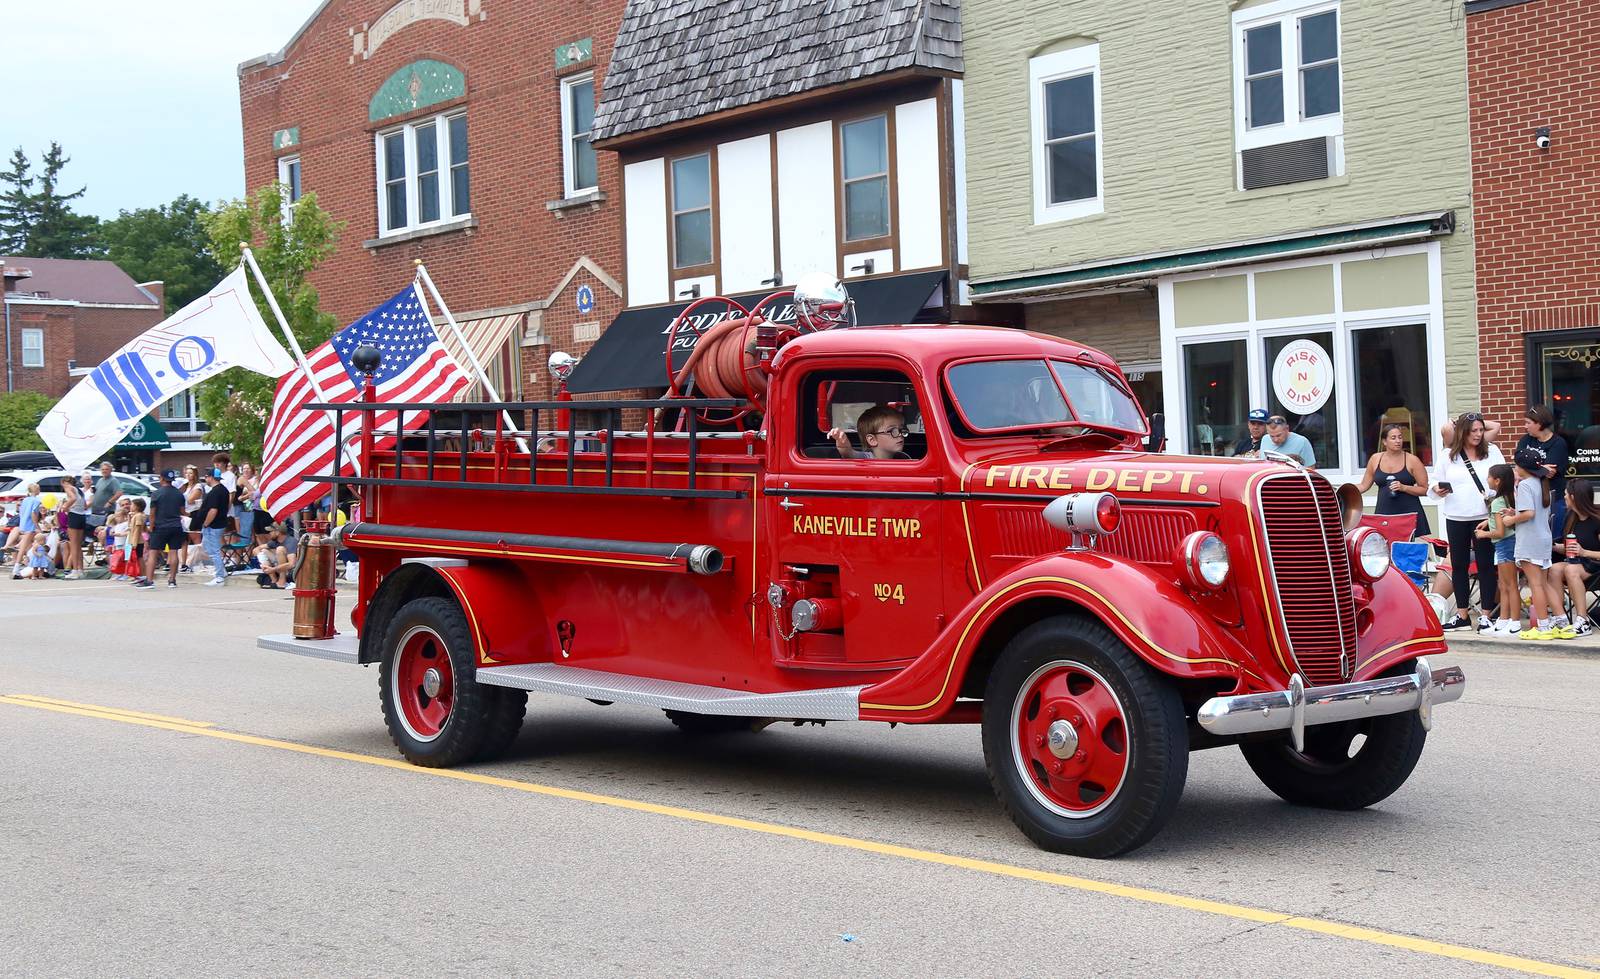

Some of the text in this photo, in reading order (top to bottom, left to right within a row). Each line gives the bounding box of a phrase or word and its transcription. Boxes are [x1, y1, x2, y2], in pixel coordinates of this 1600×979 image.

[672, 337, 698, 349] PU
[1286, 351, 1318, 367] RISE
[1297, 372, 1308, 381] N
[1286, 386, 1320, 403] DINE
[985, 465, 1209, 495] FIRE DEPT.
[793, 514, 922, 539] KANEVILLE TWP.
